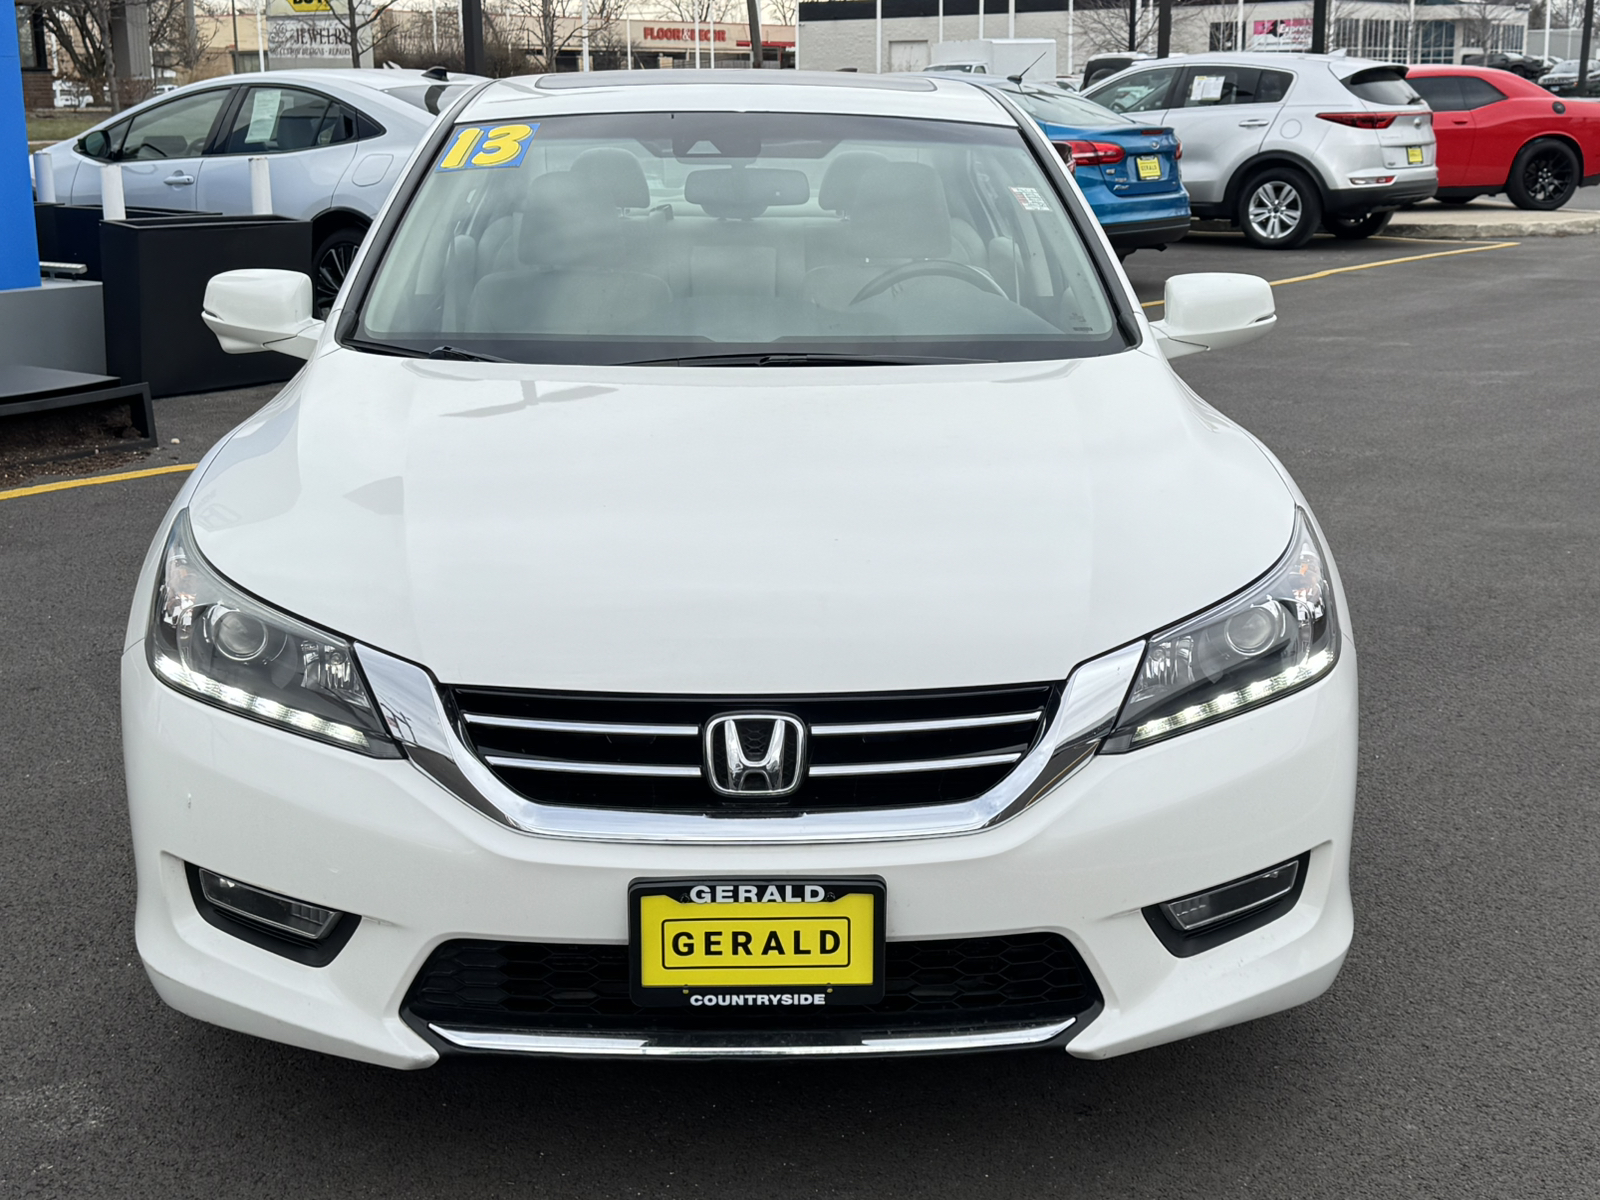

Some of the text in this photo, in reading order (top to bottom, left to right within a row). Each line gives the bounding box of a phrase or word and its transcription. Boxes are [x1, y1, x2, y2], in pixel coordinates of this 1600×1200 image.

[294, 28, 351, 46] JEWELRY
[440, 124, 533, 168] 13
[690, 884, 826, 904] GERALD
[671, 929, 841, 957] GERALD
[689, 993, 826, 1006] COUNTRYSIDE
